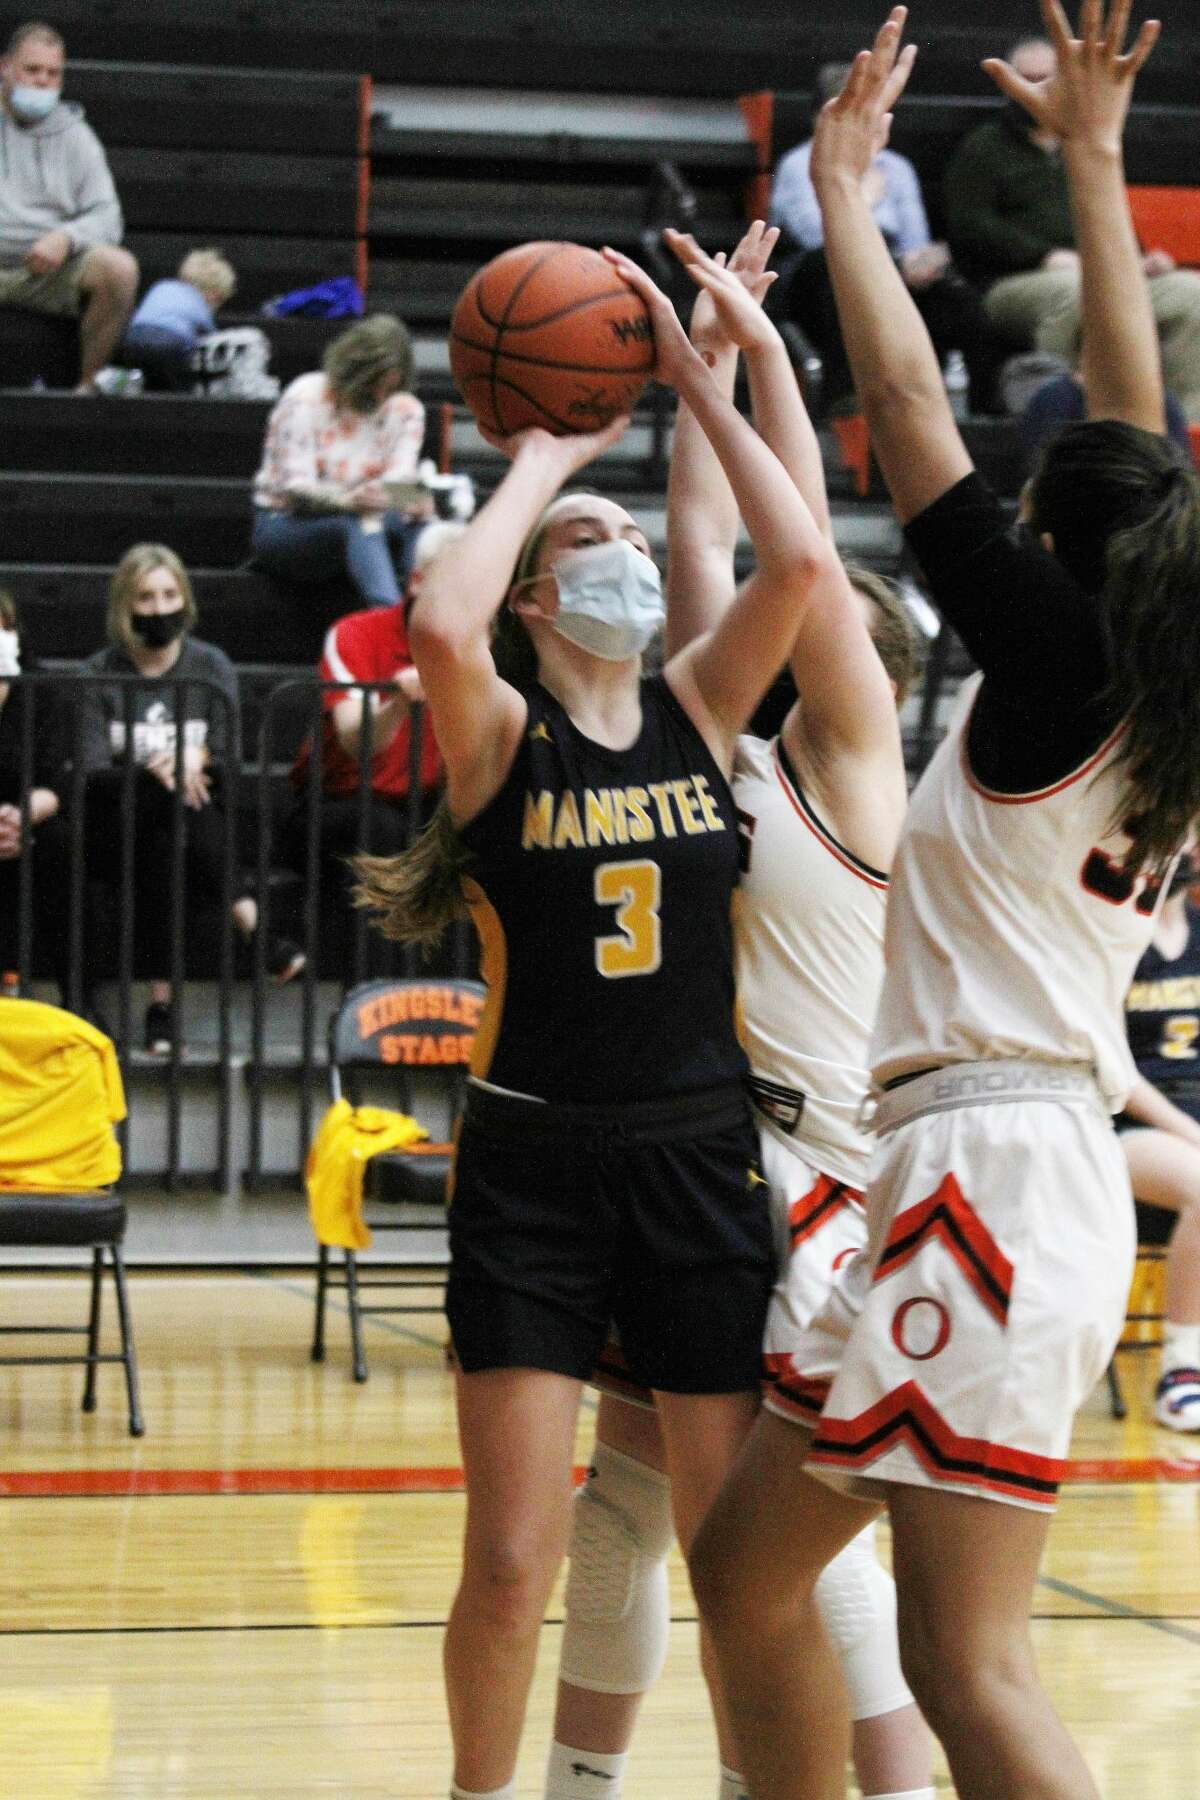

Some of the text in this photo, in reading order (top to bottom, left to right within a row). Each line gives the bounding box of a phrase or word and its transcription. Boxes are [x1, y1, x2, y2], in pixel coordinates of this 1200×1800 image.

[521, 773, 727, 850] MANISTEE
[593, 857, 663, 980] 3
[357, 984, 486, 1040] KINGSLE
[1160, 1014, 1200, 1060] 2
[890, 1296, 951, 1361] O
